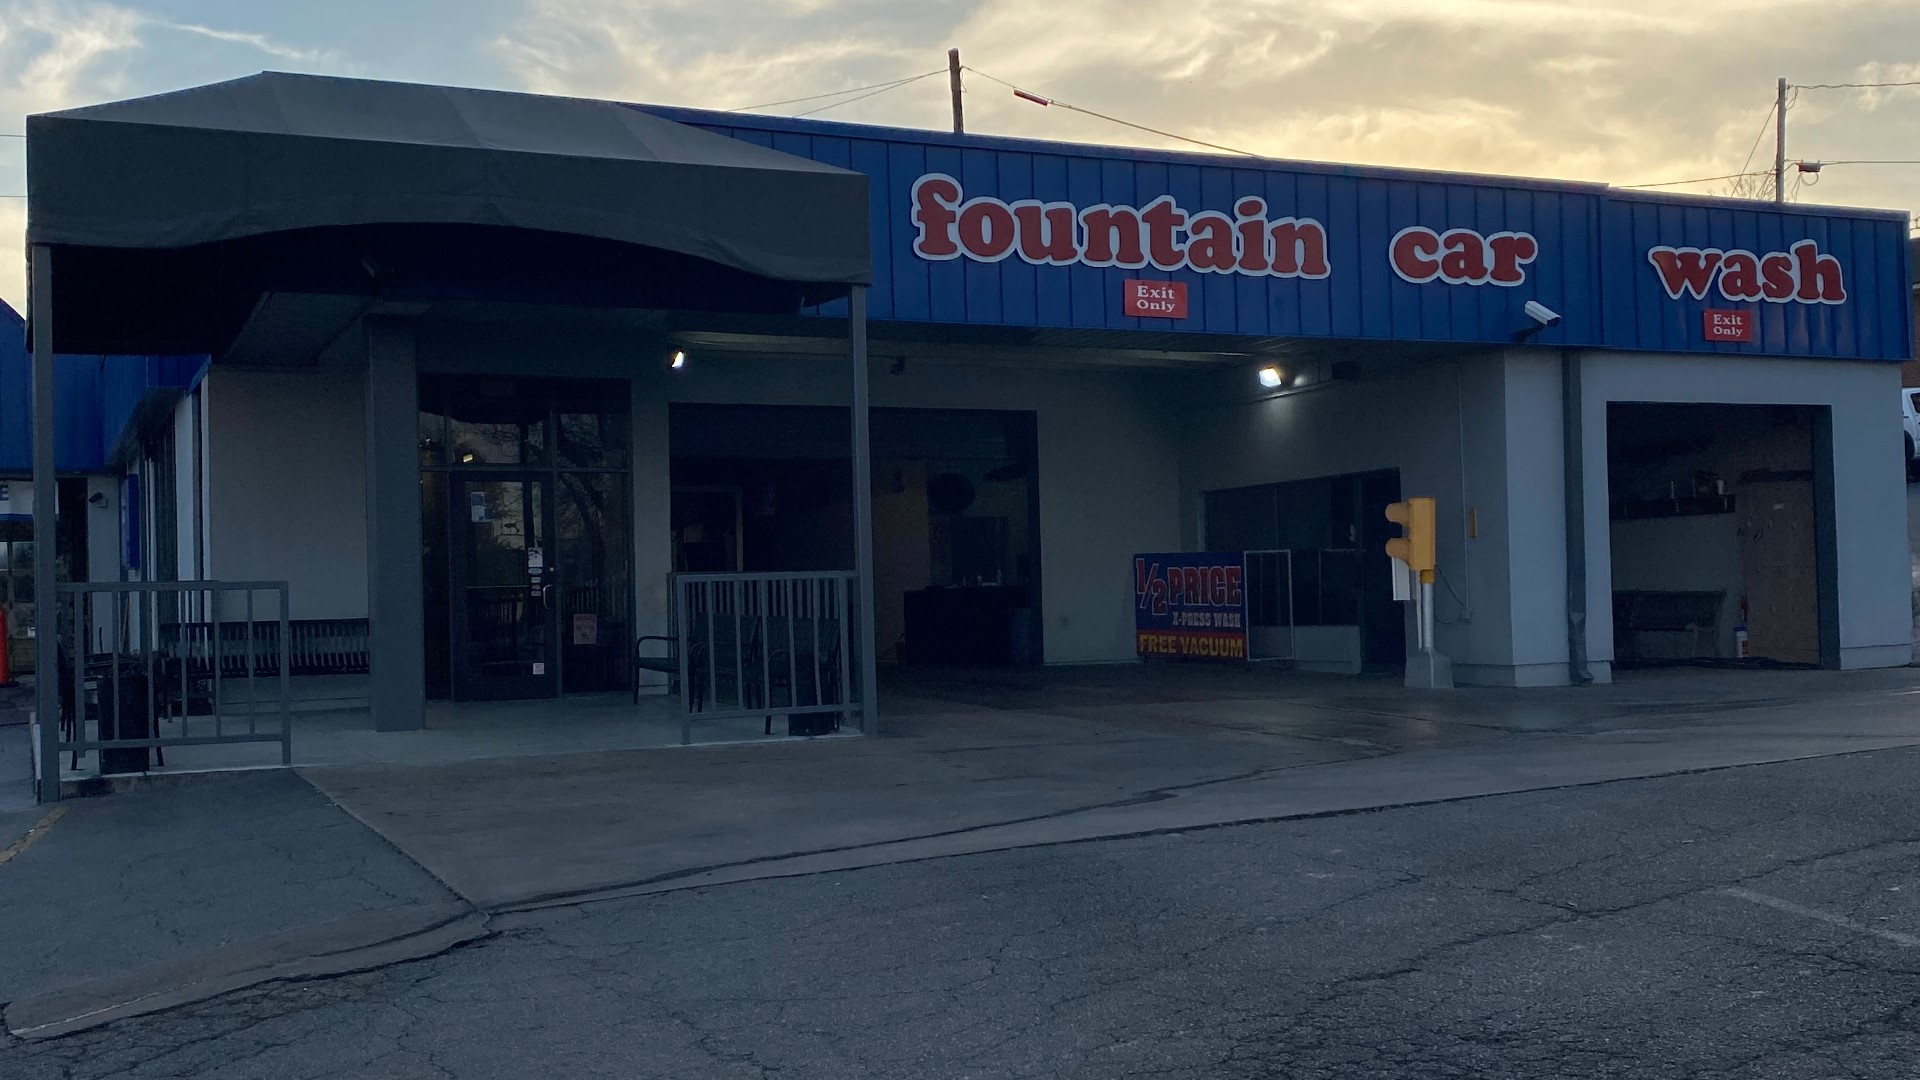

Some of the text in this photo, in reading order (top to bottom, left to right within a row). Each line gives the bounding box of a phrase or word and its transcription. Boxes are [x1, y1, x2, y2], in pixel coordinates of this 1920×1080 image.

[912, 174, 1846, 304] fountain car wash
[1137, 285, 1175, 299] Exit
[1136, 299, 1176, 312] Only
[1713, 314, 1743, 325] Exit
[1713, 326, 1744, 337] Only
[1167, 566, 1242, 607] PRICE
[1172, 611, 1241, 628] X-PRESS WASH
[1140, 634, 1243, 658] FREE VACUUM
